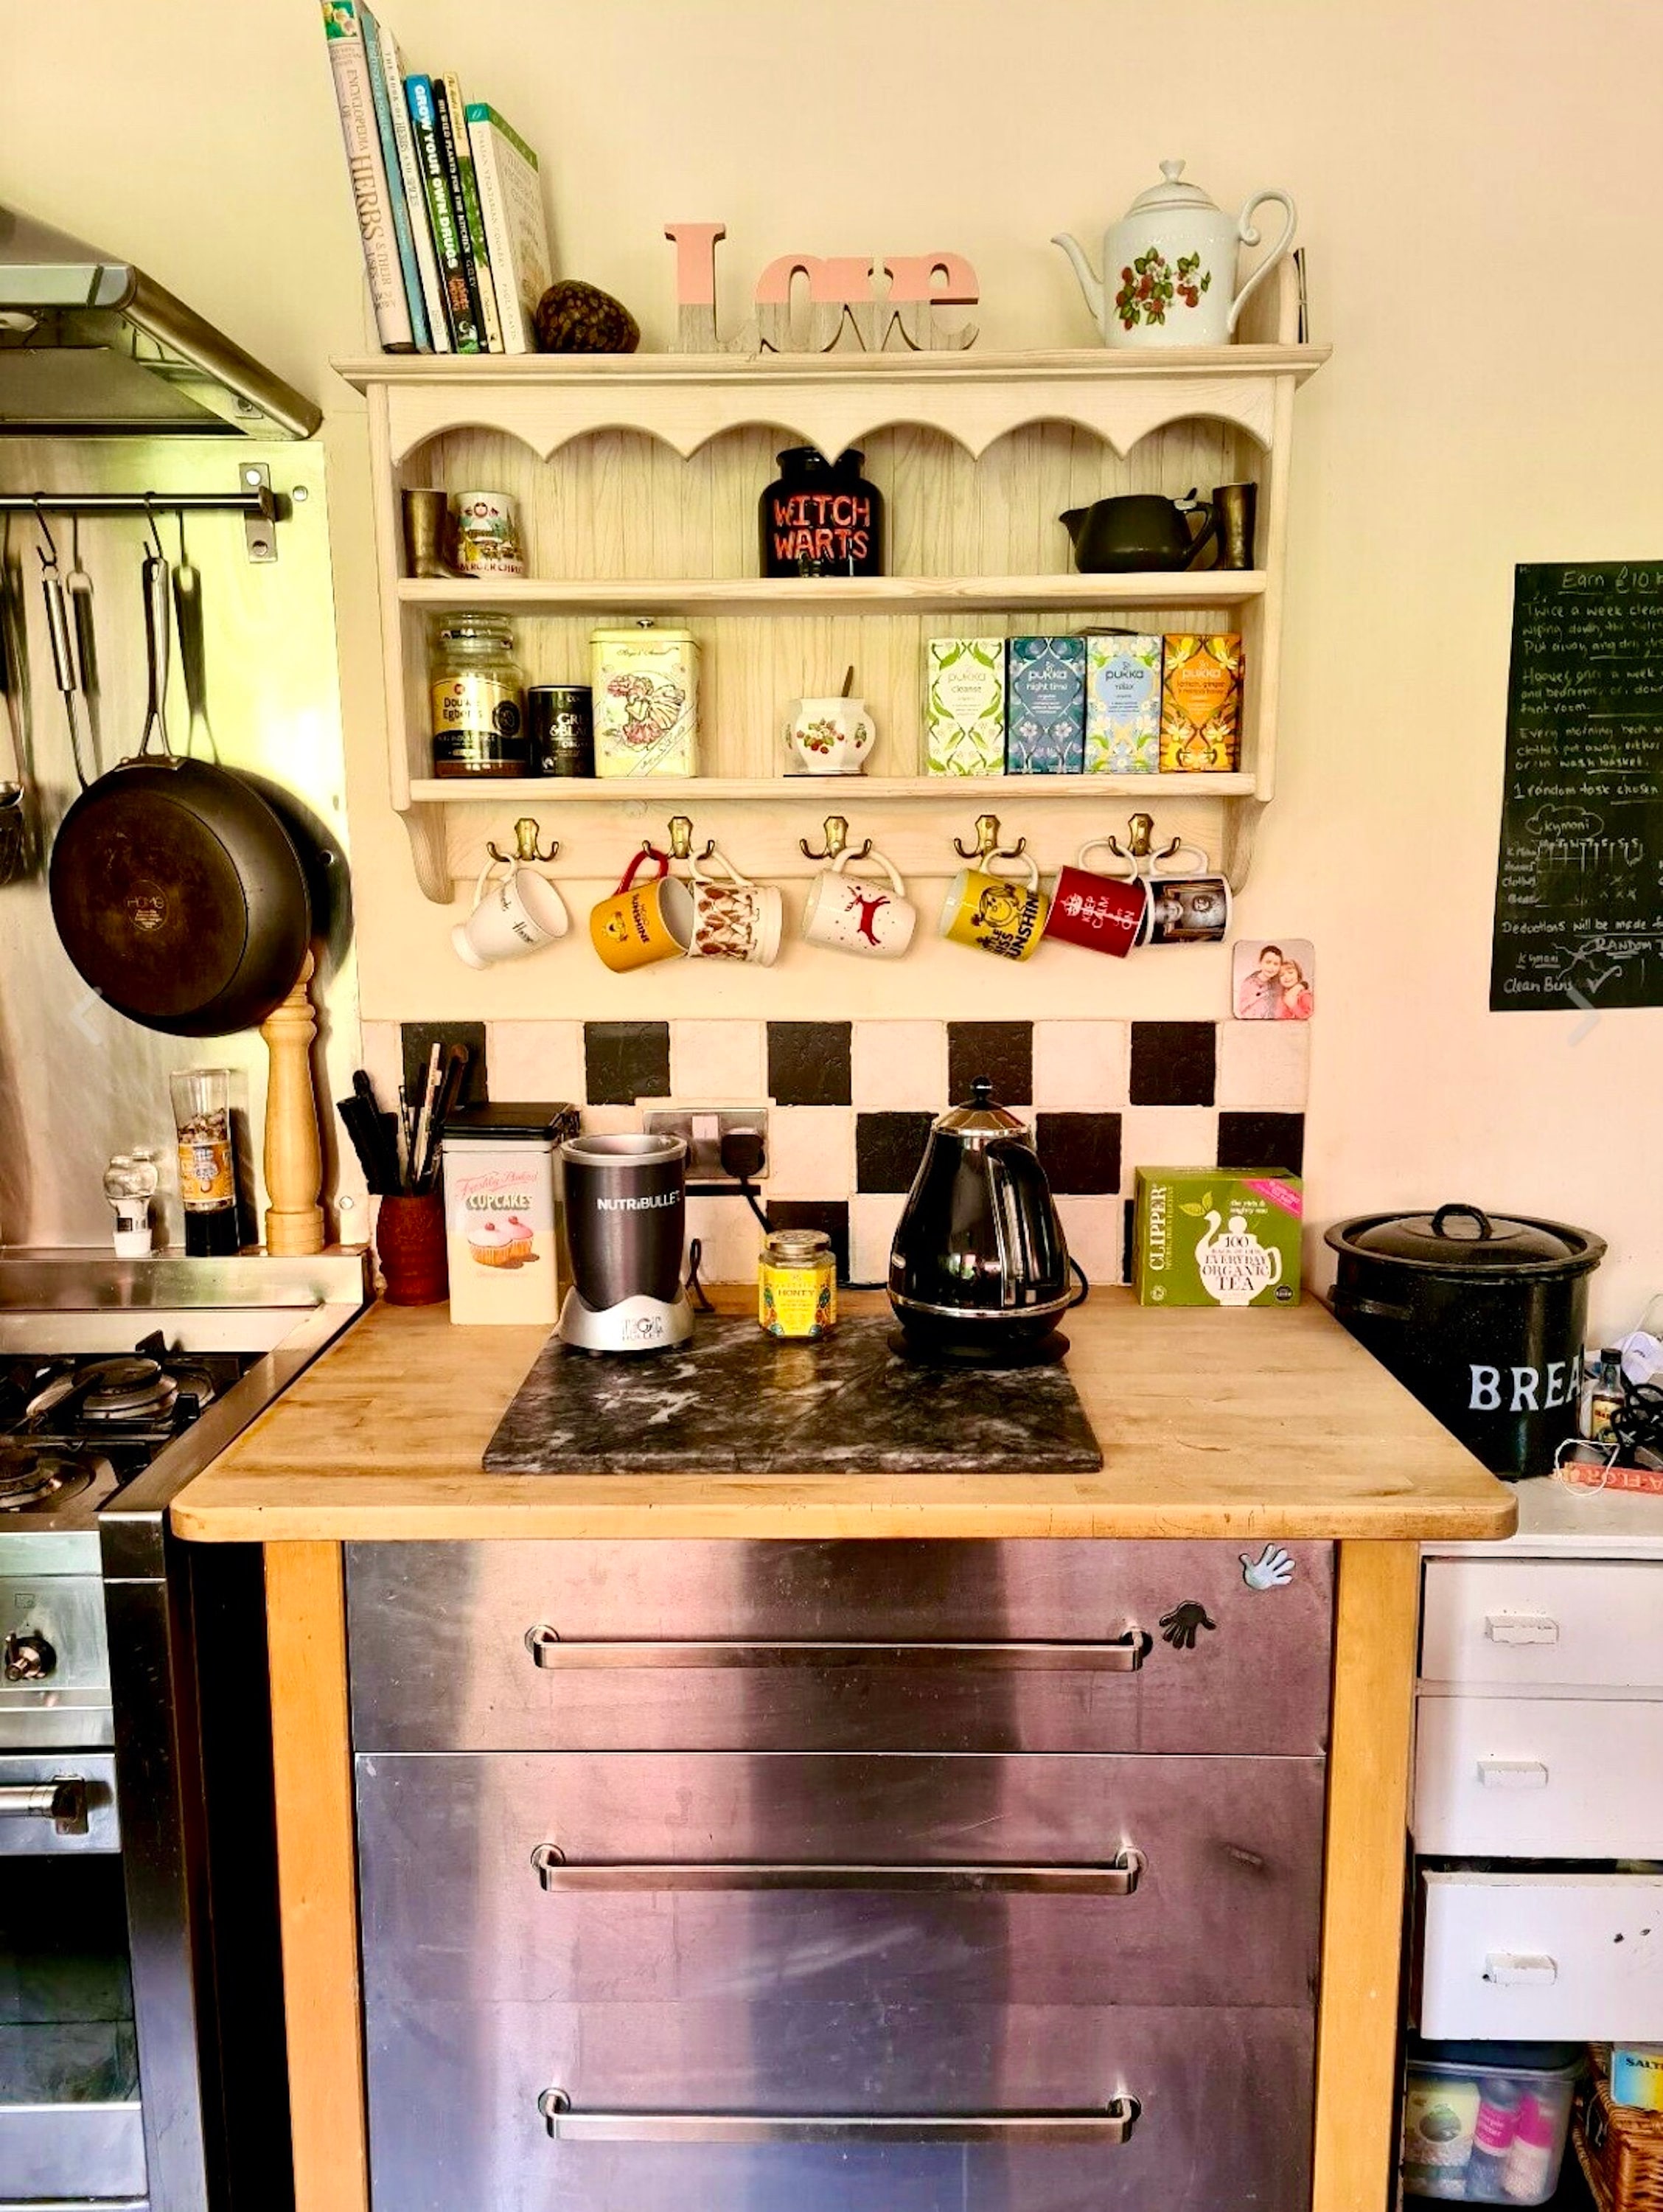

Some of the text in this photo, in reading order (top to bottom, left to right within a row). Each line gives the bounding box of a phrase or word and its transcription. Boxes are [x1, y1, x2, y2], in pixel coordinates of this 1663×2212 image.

[413, 85, 459, 269] GROW YOUR OWN DRUGS
[347, 153, 386, 240] HERBS
[444, 139, 458, 173] PLANTS
[457, 214, 473, 253] KITCHEN
[774, 495, 871, 526] WITCH
[775, 529, 870, 561] WARTS
[1562, 570, 1605, 588] Earn
[1586, 607, 1622, 616] week
[1524, 639, 1547, 655] Put
[948, 672, 986, 683] pukka
[1029, 669, 1067, 681] pukka
[1106, 669, 1143, 681] pukka
[1182, 669, 1221, 679] pukka
[951, 684, 982, 693] cleanse
[1026, 682, 1068, 693] night time
[1520, 688, 1543, 700] and
[1517, 727, 1559, 742] Every
[1559, 758, 1596, 768] wash
[1527, 780, 1577, 796] random
[1617, 782, 1659, 795] chosen
[632, 892, 650, 944] SUNSHINE
[1092, 896, 1110, 929] CALM
[1501, 920, 1566, 934] Deductions
[1595, 918, 1608, 931] be
[1615, 919, 1647, 930] made
[1595, 936, 1653, 951] RANDOM
[1502, 977, 1541, 994] Clean
[1149, 1186, 1167, 1271] CLIPPER
[1226, 1236, 1249, 1248] 100
[1205, 1256, 1266, 1265] EVERYDAY
[1202, 1265, 1269, 1276] ORGANIC
[1216, 1276, 1255, 1291] TEA
[778, 1289, 815, 1298] HONEY
[1468, 1354, 1583, 1411] BREA
